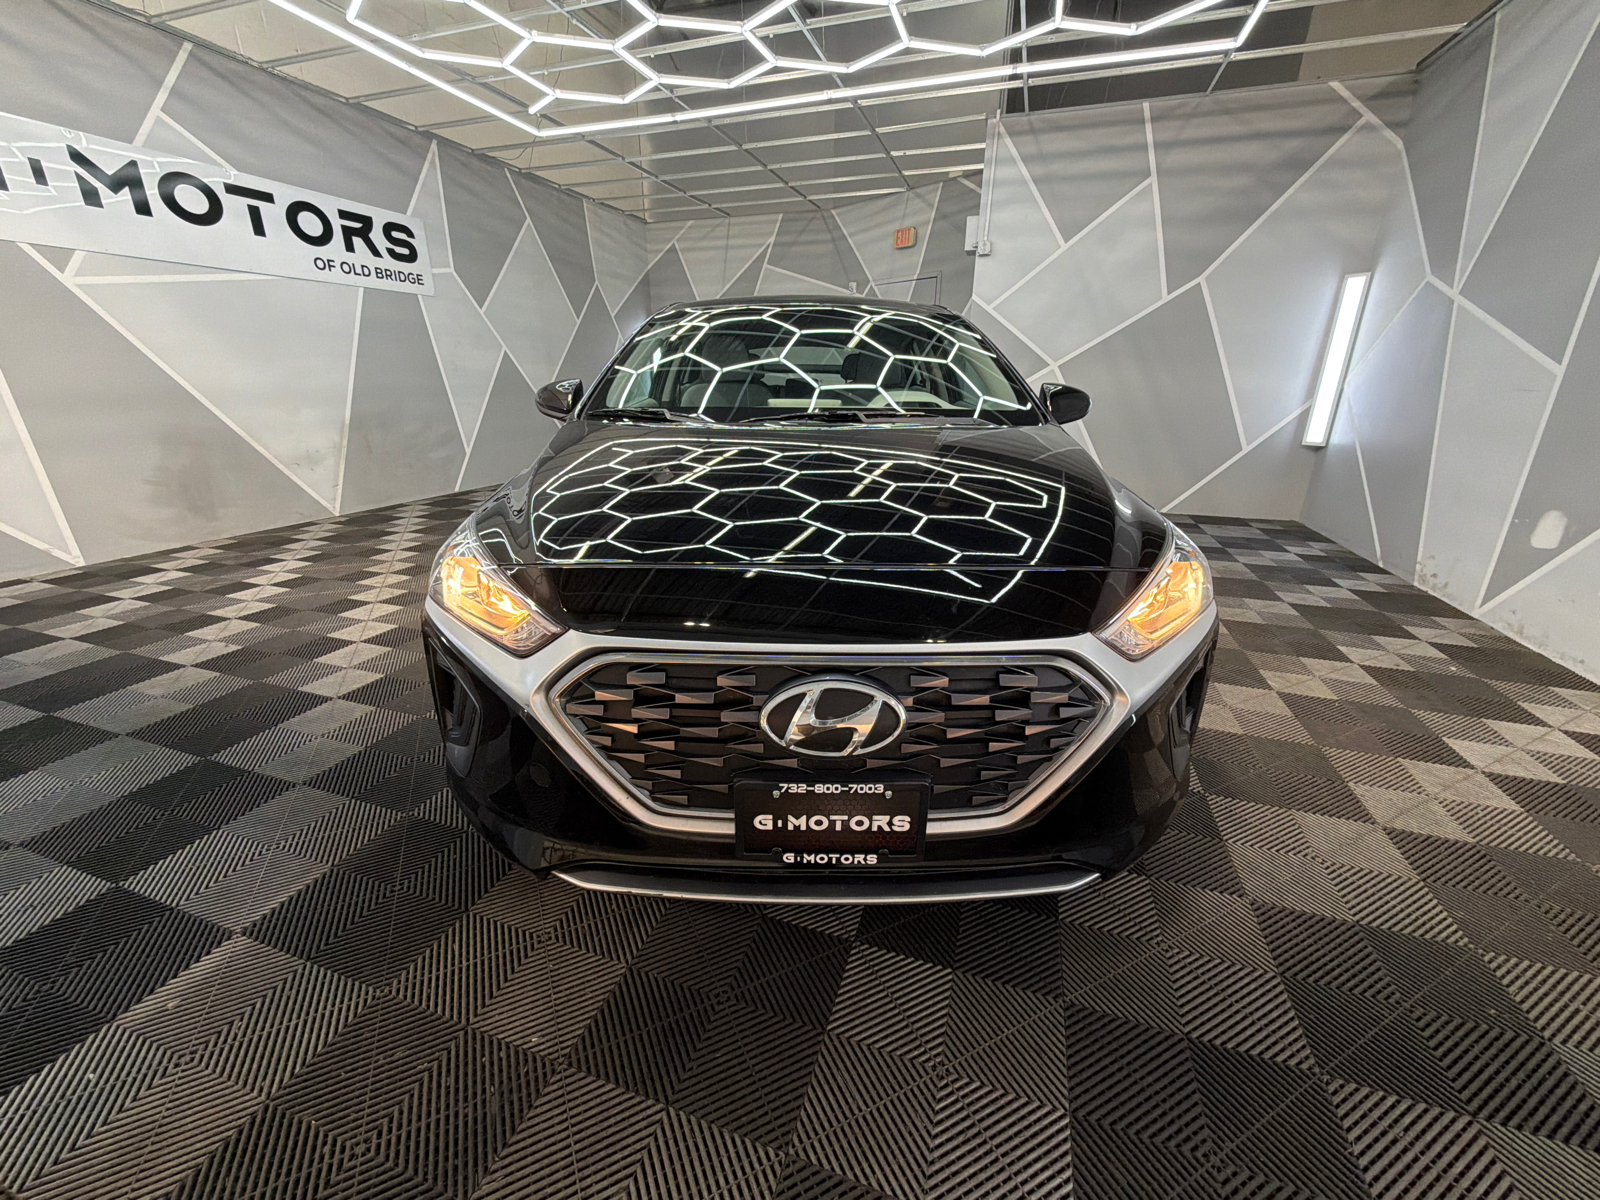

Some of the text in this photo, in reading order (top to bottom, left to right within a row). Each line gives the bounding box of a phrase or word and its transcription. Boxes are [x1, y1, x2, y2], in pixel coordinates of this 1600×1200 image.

[896, 228, 912, 247] EXIT
[313, 257, 425, 286] OF OLD BRIDGE
[779, 783, 885, 794] 732-800-7003
